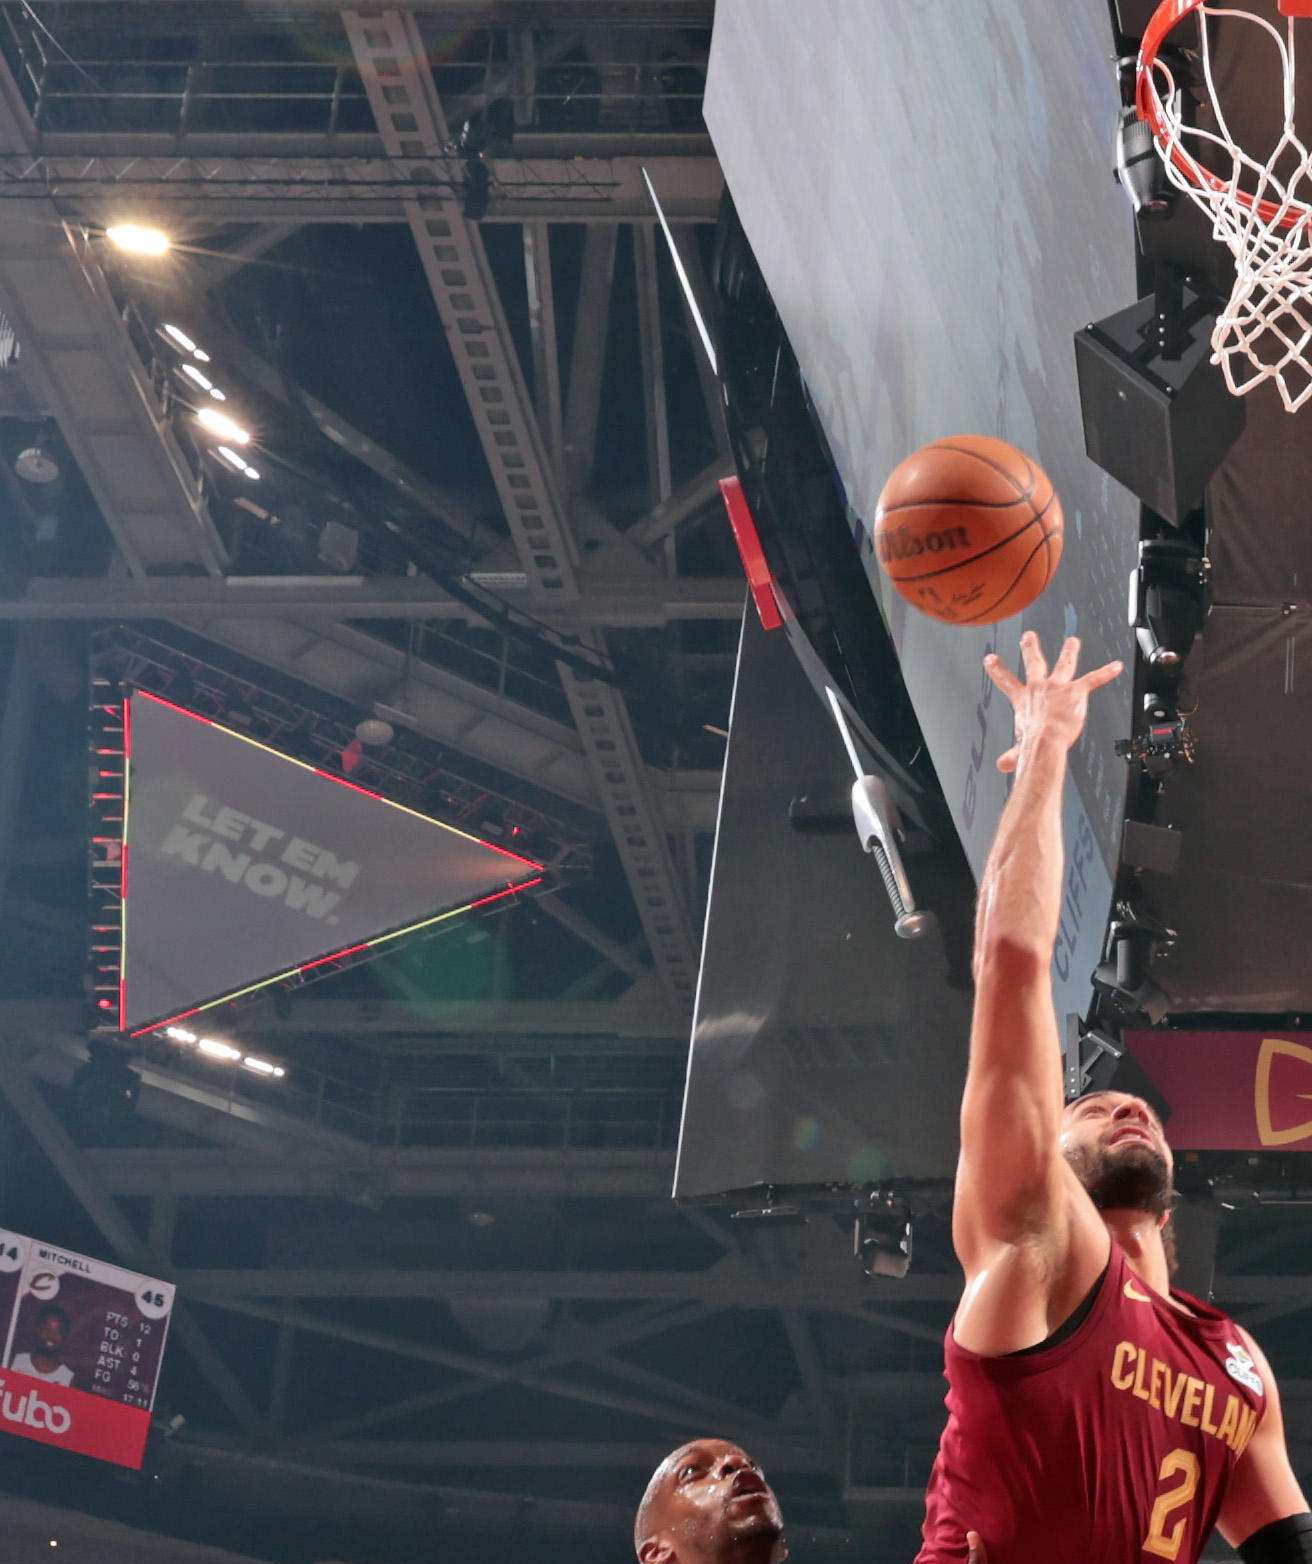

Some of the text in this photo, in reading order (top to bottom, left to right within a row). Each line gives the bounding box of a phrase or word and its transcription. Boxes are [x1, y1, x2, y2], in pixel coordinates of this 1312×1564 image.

[183, 794, 361, 888] LET EM
[38, 1248, 91, 1274] MITCHELL
[141, 1289, 164, 1308] 45
[104, 1327, 119, 1340] TO
[106, 1311, 152, 1335] PTS 12
[97, 1355, 121, 1370] AST
[100, 1341, 140, 1362] BLK 0
[95, 1369, 111, 1383] FG
[1111, 1341, 1257, 1458] CLEVELAN
[1142, 1448, 1201, 1561] 2
